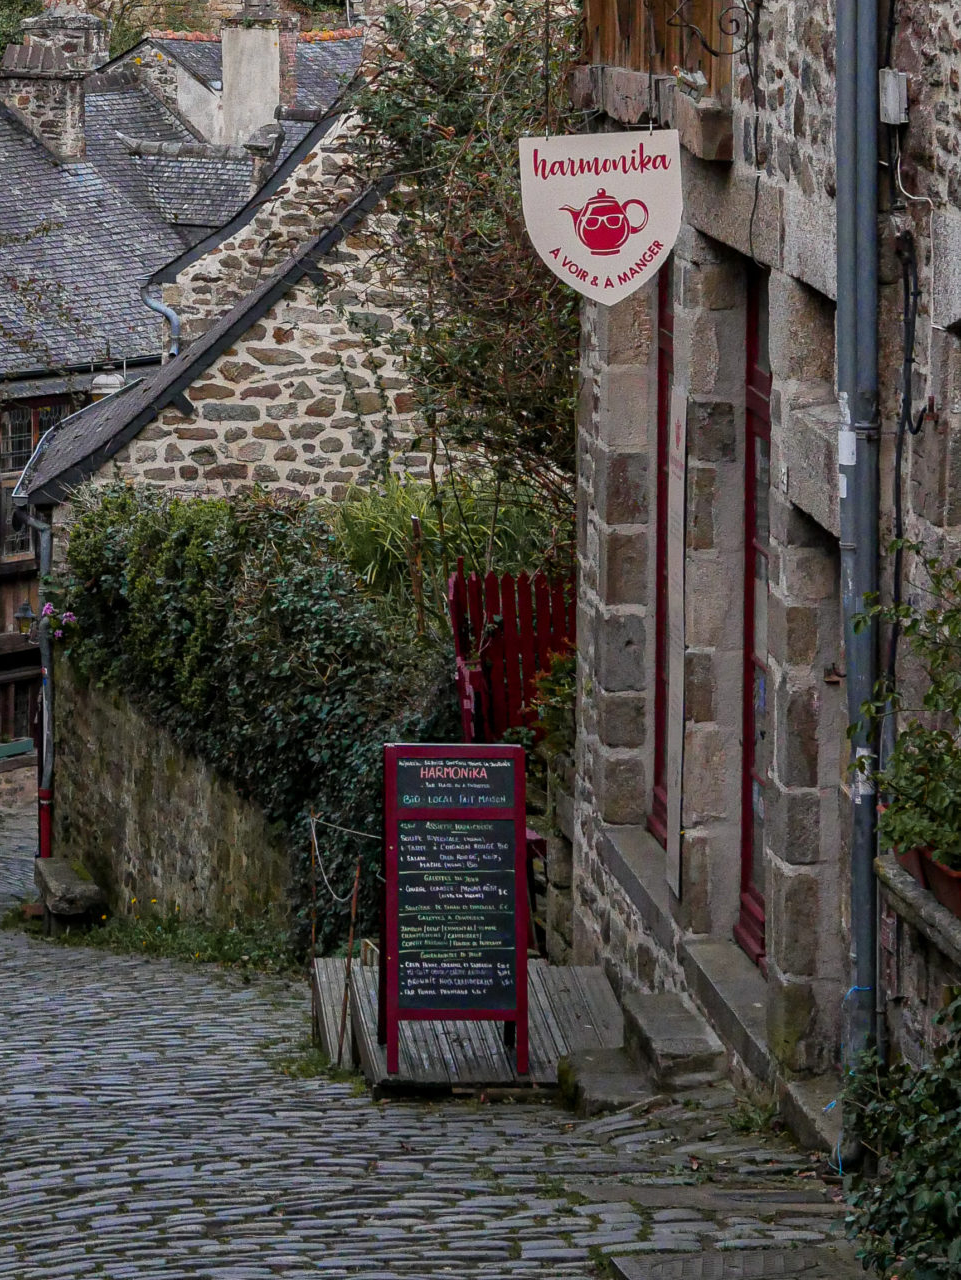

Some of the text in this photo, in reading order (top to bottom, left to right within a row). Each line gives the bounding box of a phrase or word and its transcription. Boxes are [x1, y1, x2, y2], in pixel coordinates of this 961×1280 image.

[533, 142, 671, 180] harmonika
[562, 256, 589, 282] VOIR
[590, 276, 599, 287] &
[617, 239, 664, 285] MANGER
[428, 795, 452, 803] LOCAL
[459, 794, 474, 803] FAIT
[478, 795, 506, 803] MAISON
